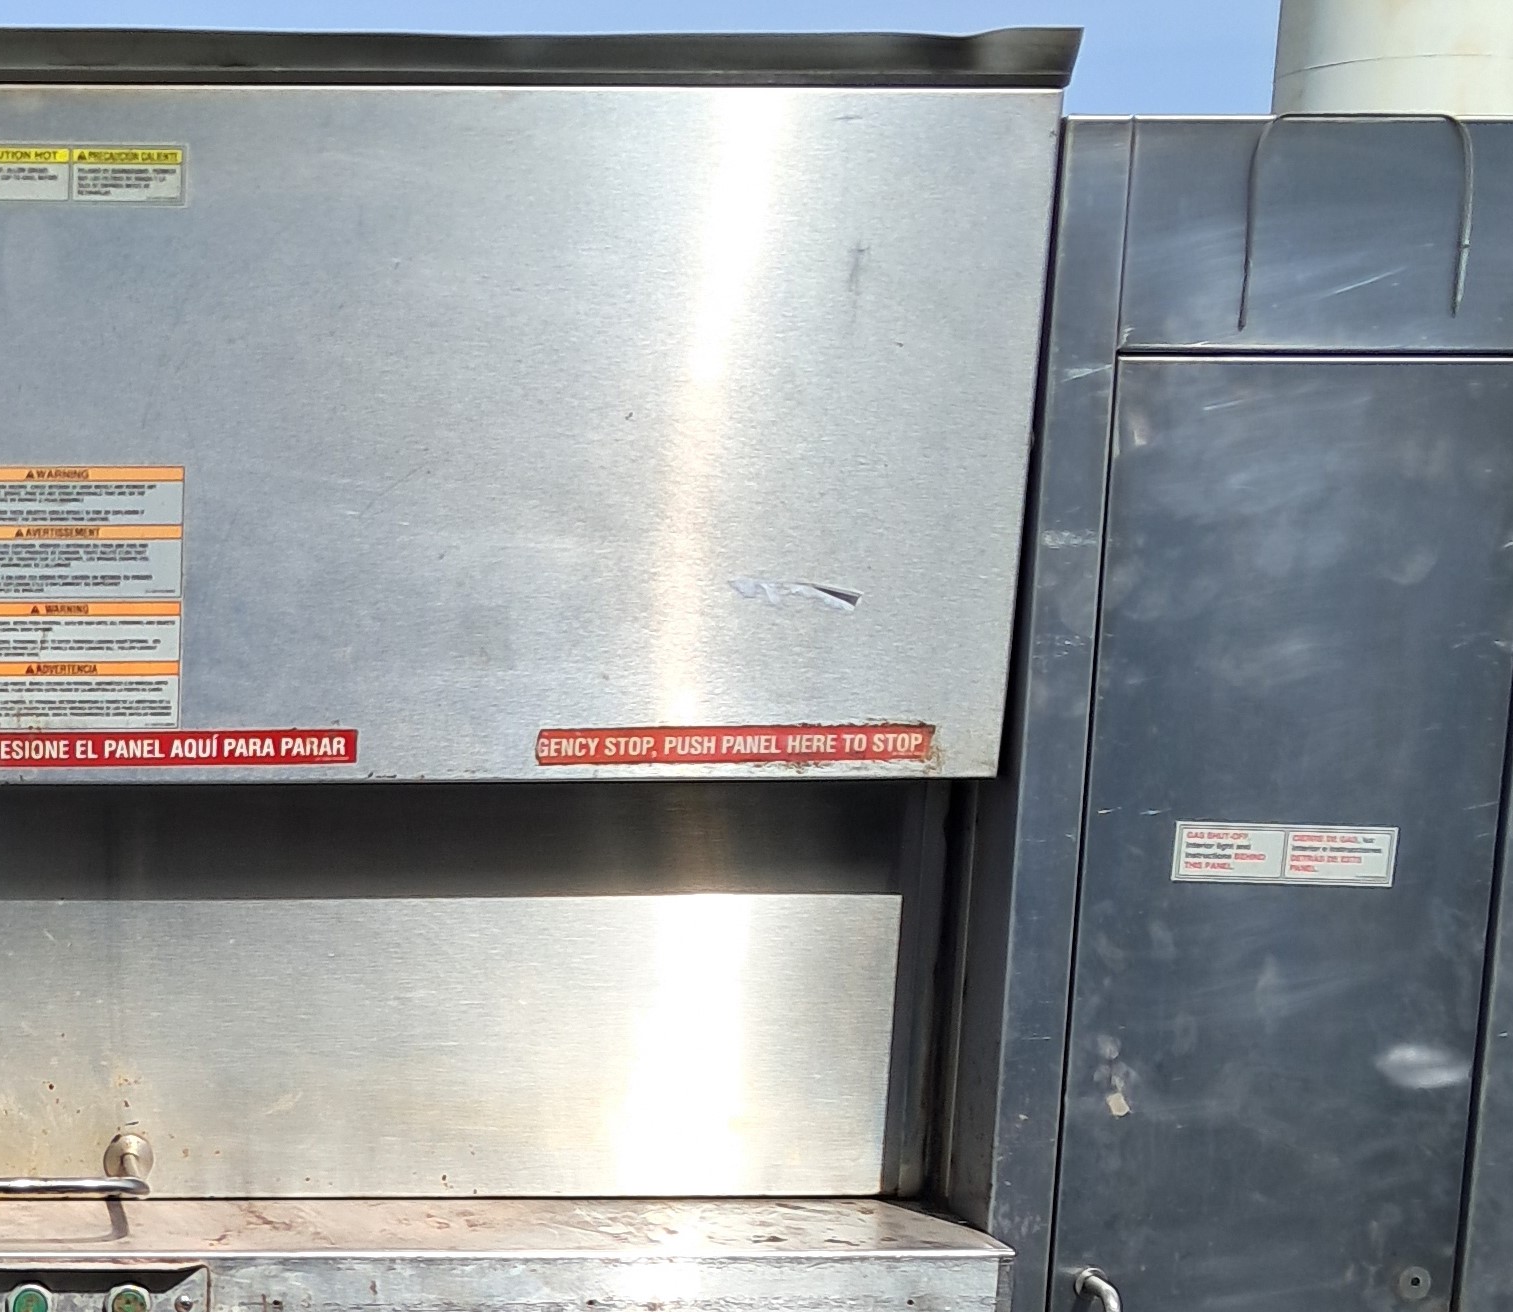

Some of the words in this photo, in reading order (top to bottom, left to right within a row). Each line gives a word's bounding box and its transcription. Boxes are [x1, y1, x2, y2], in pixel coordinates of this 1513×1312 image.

[35, 151, 58, 160] HOT
[37, 469, 90, 479] WARNING
[25, 528, 100, 537] AVERTISSEMENT
[45, 605, 89, 614] WARNING
[36, 664, 98, 674] ADVERTENCIA
[75, 739, 99, 759] EL
[104, 738, 165, 758] PANEL
[170, 734, 218, 758] AQUÍ
[223, 738, 275, 757] PARA
[280, 736, 346, 756] PARAR
[538, 738, 600, 757] GENCY
[604, 737, 658, 758] STOP,
[664, 736, 716, 756] PUSH
[721, 735, 781, 754] PANEL
[787, 734, 837, 754] HERE
[843, 734, 868, 753] TO
[872, 733, 924, 752] STOP
